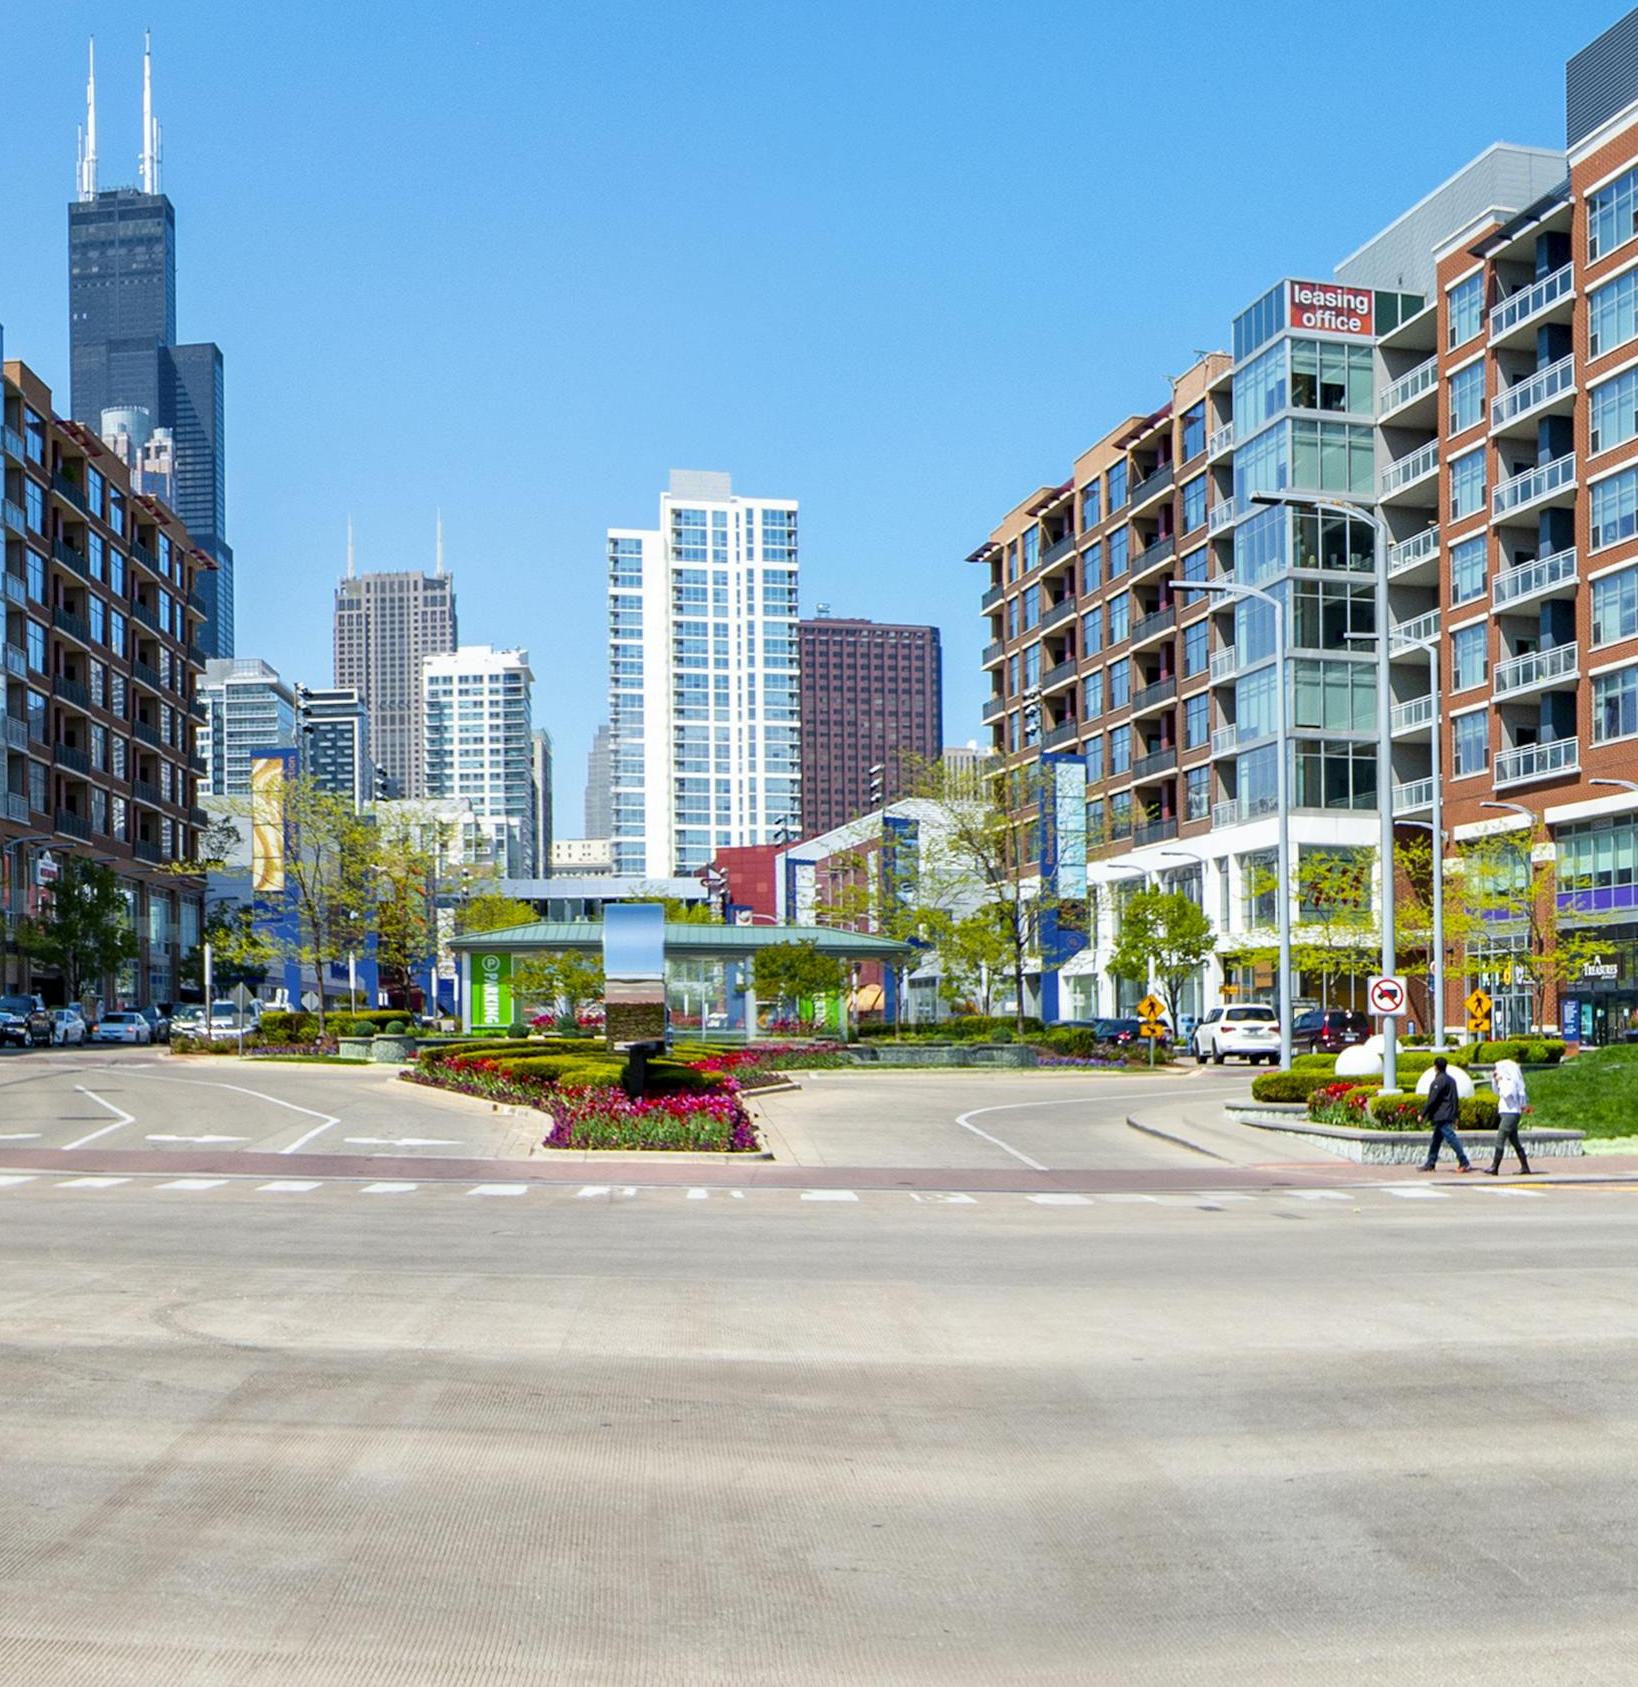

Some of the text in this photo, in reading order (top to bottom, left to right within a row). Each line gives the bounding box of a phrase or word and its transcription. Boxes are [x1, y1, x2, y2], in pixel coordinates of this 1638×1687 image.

[1294, 284, 1368, 315] leasing
[1302, 310, 1361, 332] office
[484, 973, 499, 1023] PARKING
